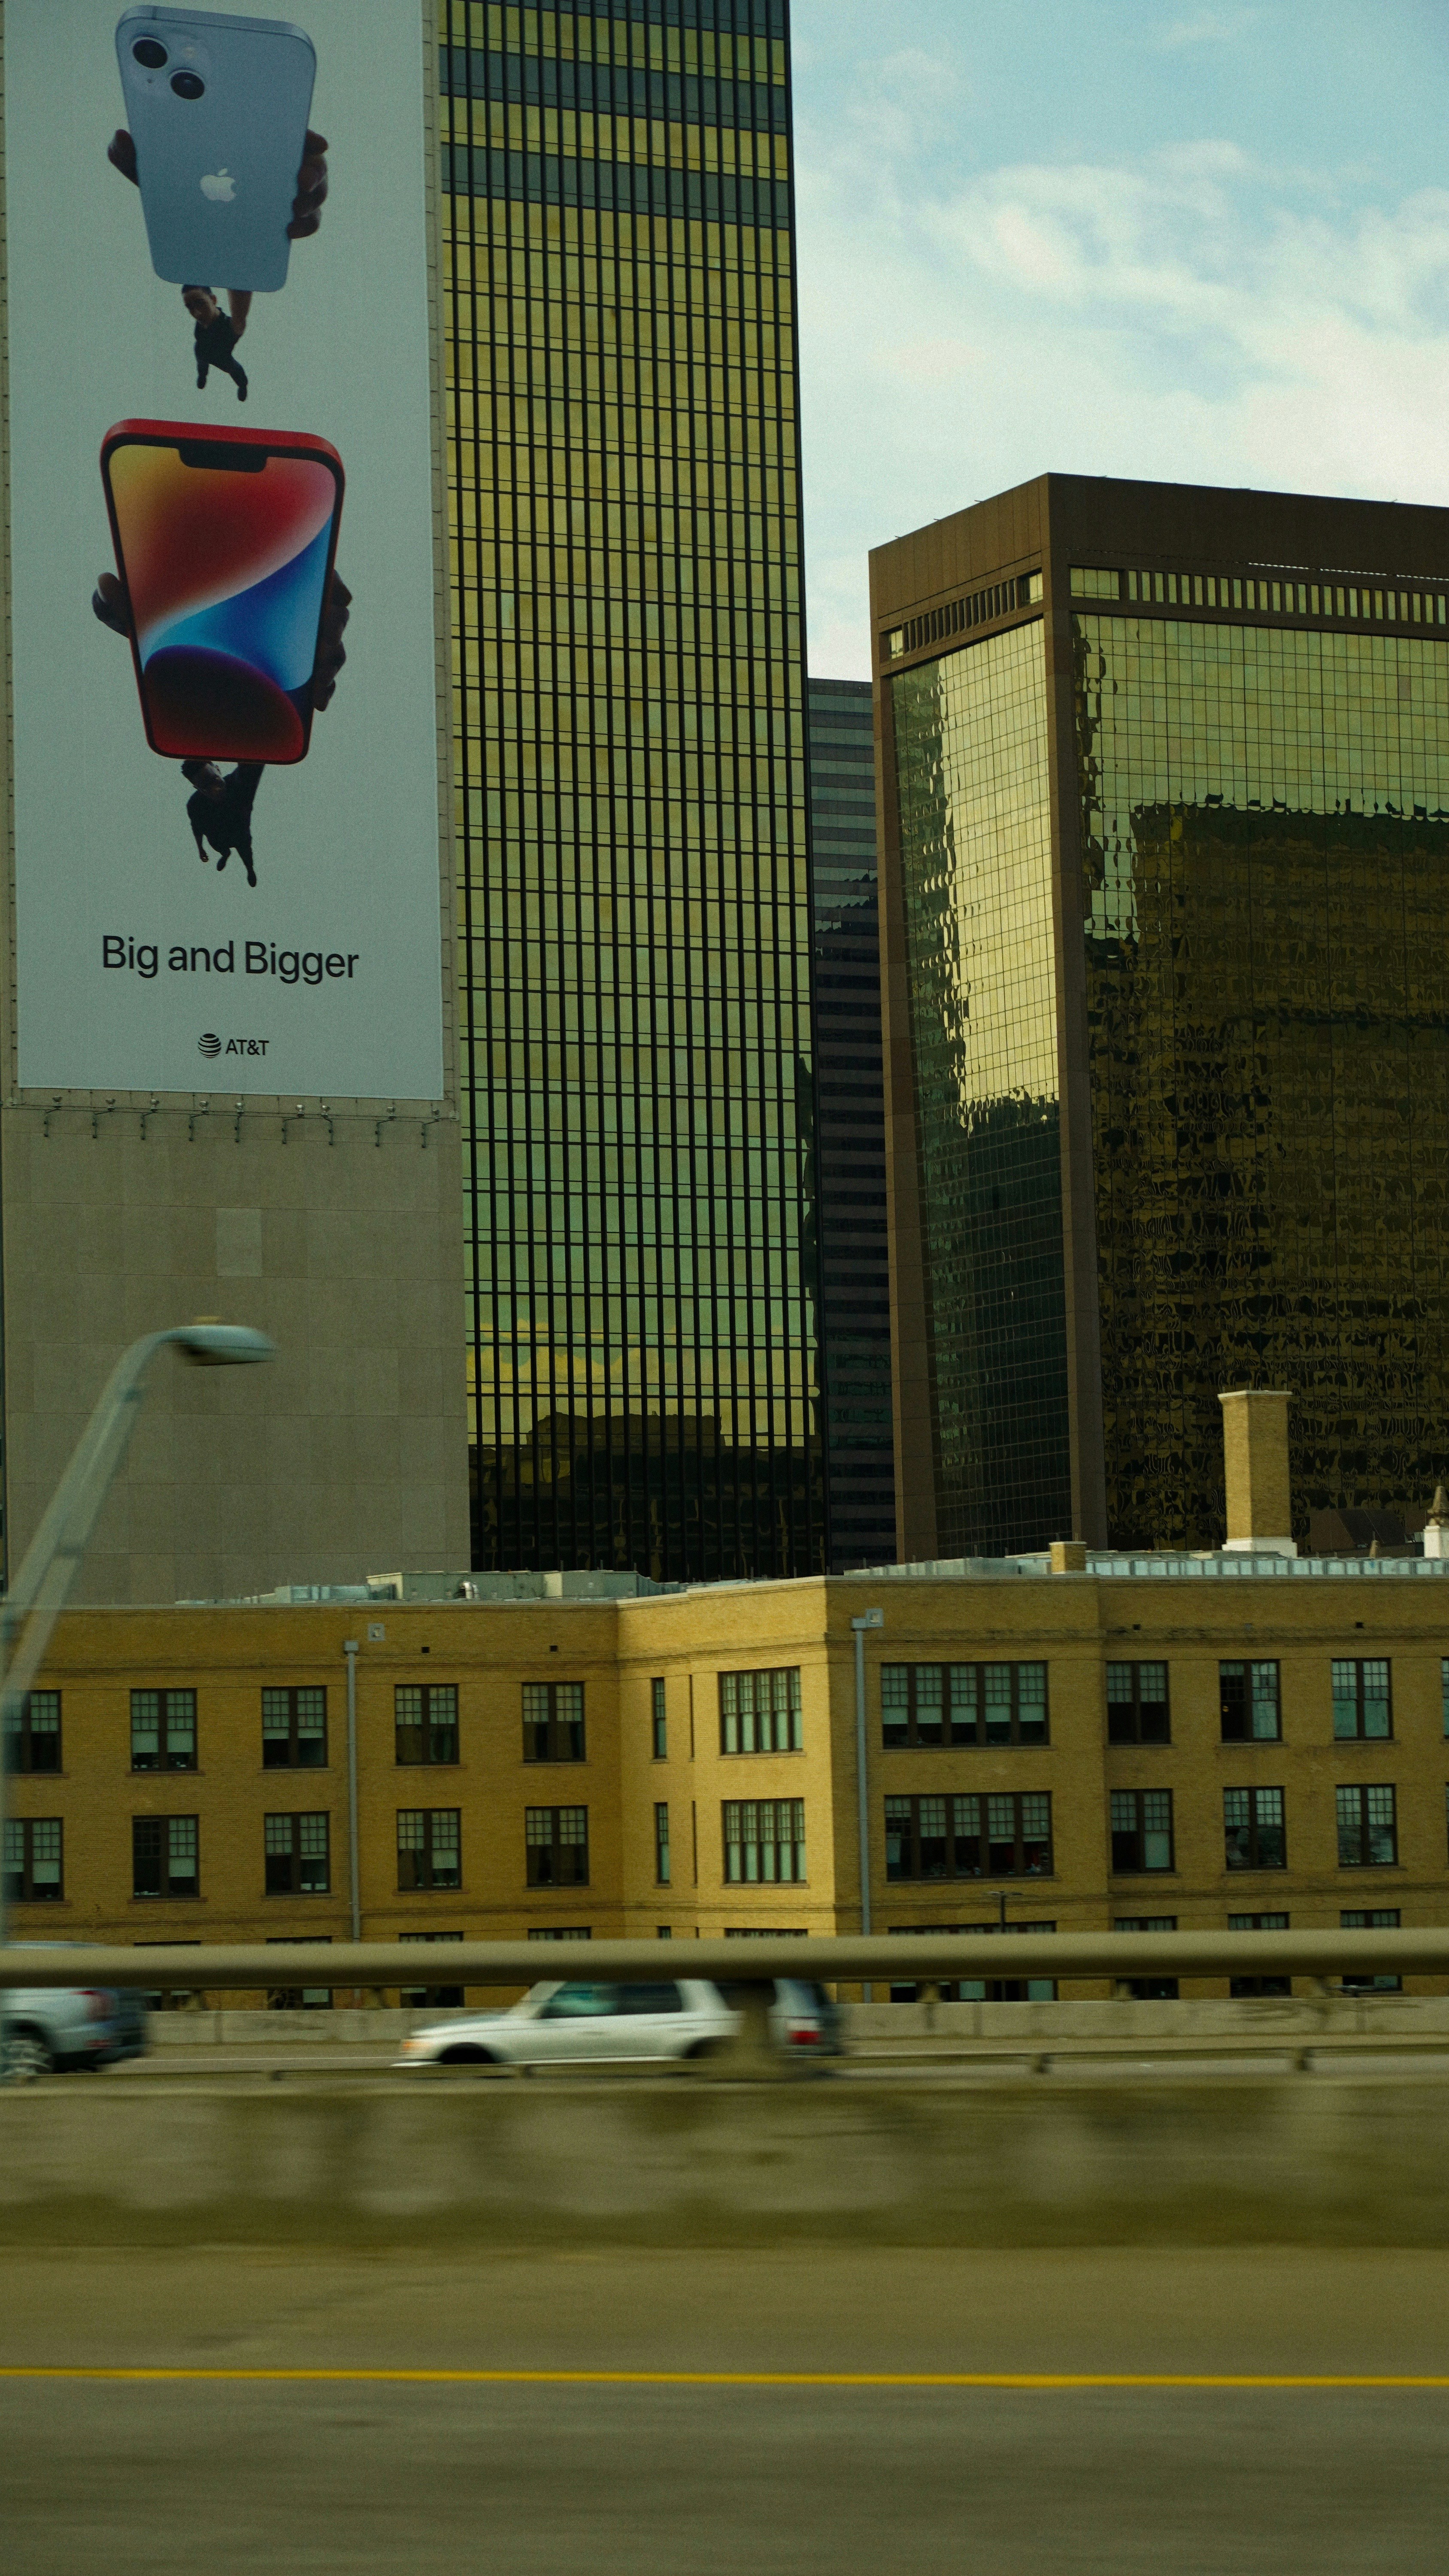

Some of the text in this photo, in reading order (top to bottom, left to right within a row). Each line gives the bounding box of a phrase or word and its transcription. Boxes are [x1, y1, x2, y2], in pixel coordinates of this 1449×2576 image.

[103, 935, 359, 985] Big and Bigger
[225, 1039, 270, 1056] AT&T
